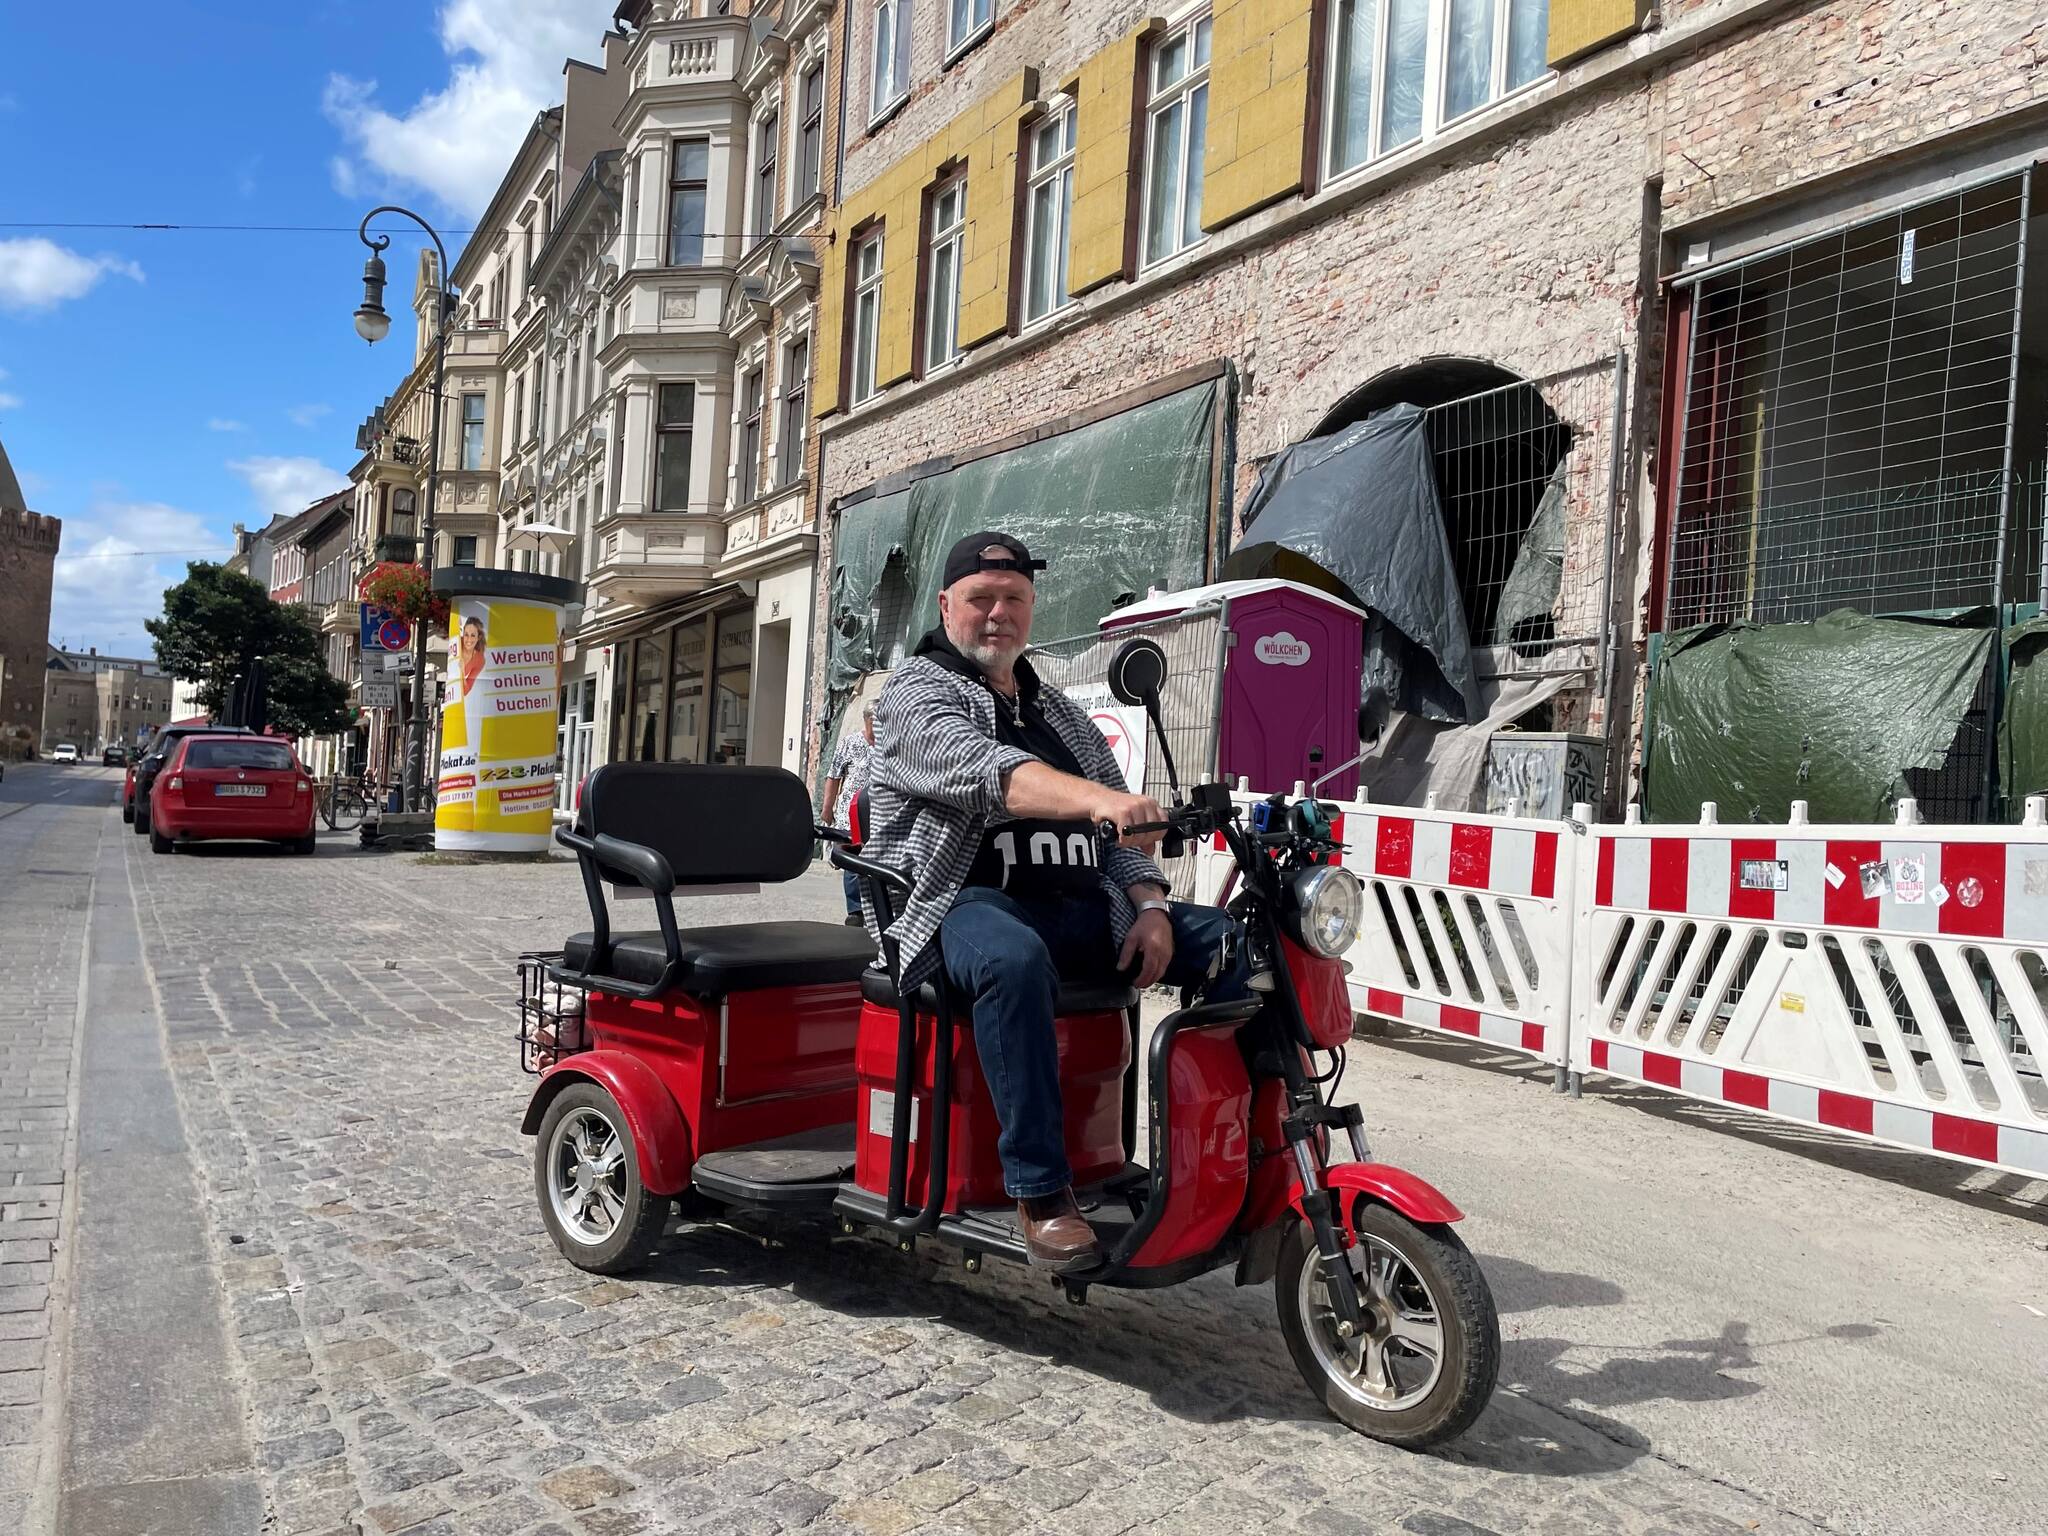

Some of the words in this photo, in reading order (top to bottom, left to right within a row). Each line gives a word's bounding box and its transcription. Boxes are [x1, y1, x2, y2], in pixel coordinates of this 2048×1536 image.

[1902, 233, 1914, 278] HERAS
[366, 606, 381, 625] P
[1263, 642, 1303, 656] WÖLKCHEN
[491, 650, 555, 664] Werbung
[494, 673, 541, 689] online
[496, 695, 552, 712] buchen!
[504, 804, 530, 813] Hotline
[1895, 881, 1924, 891] BOXING
